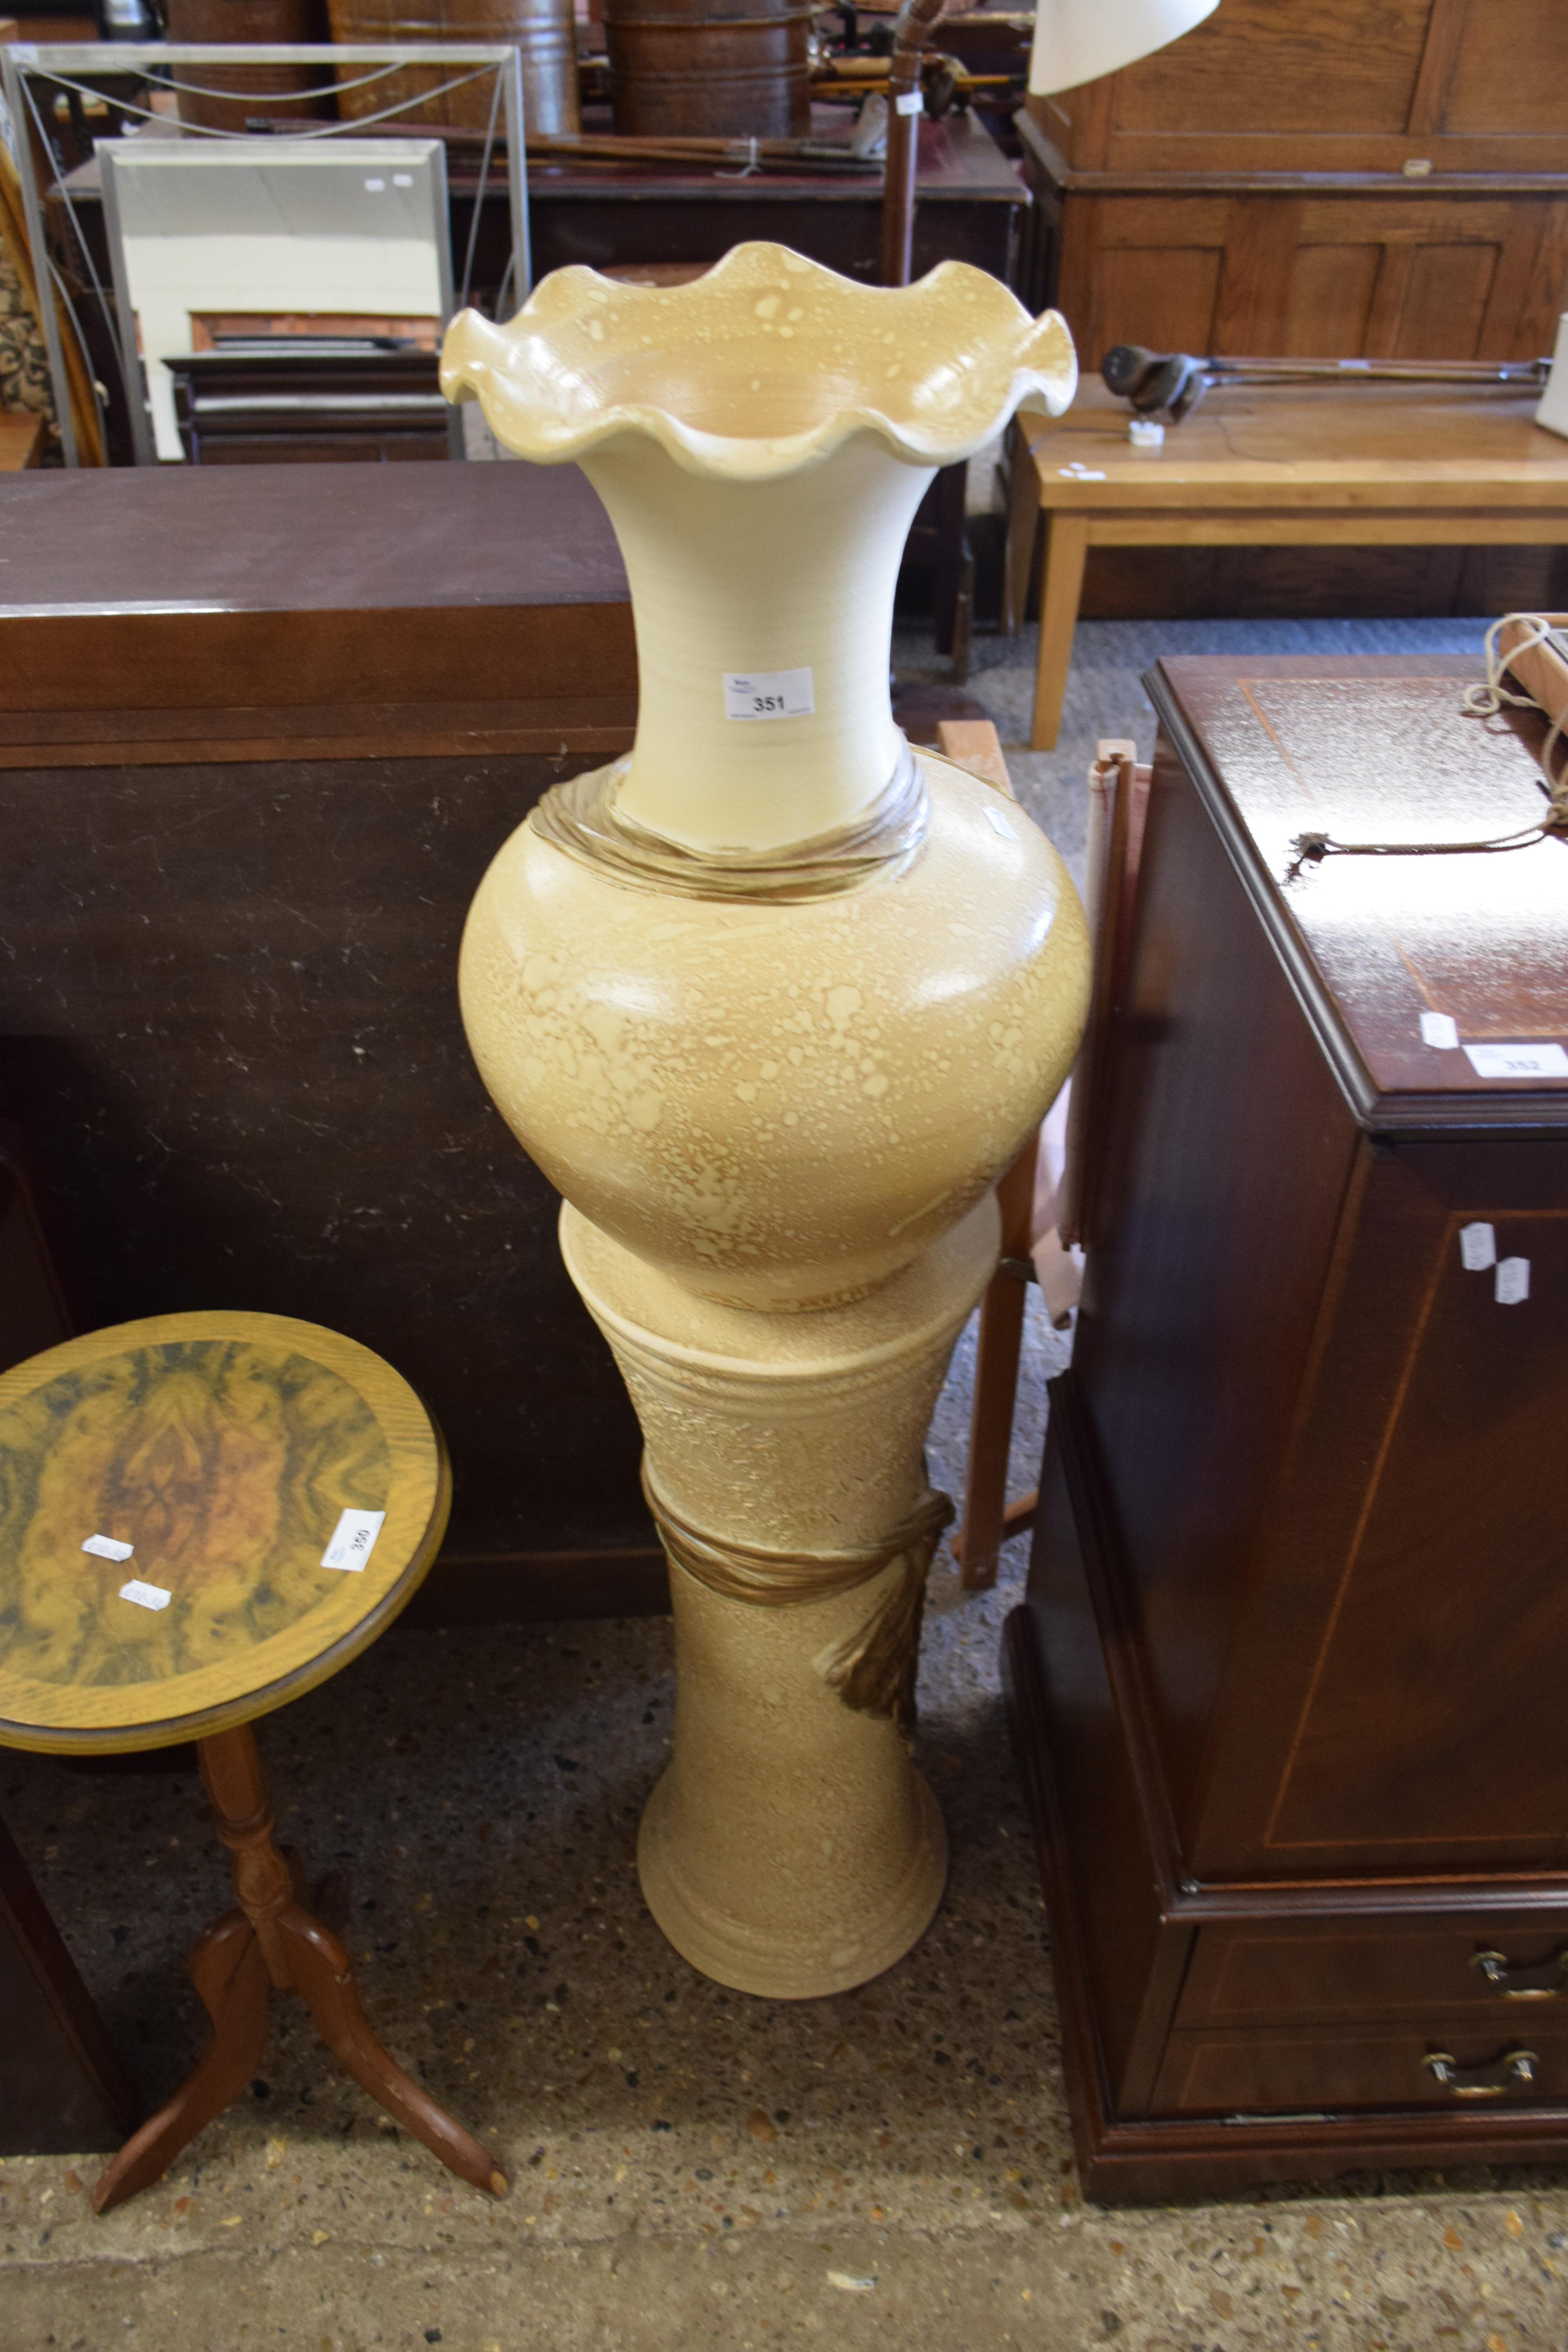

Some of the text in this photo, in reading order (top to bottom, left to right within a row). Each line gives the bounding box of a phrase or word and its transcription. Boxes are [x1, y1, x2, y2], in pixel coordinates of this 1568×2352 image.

[754, 696, 784, 711] 351
[1505, 1060, 1541, 1070] 352
[351, 1530, 370, 1551] 350
